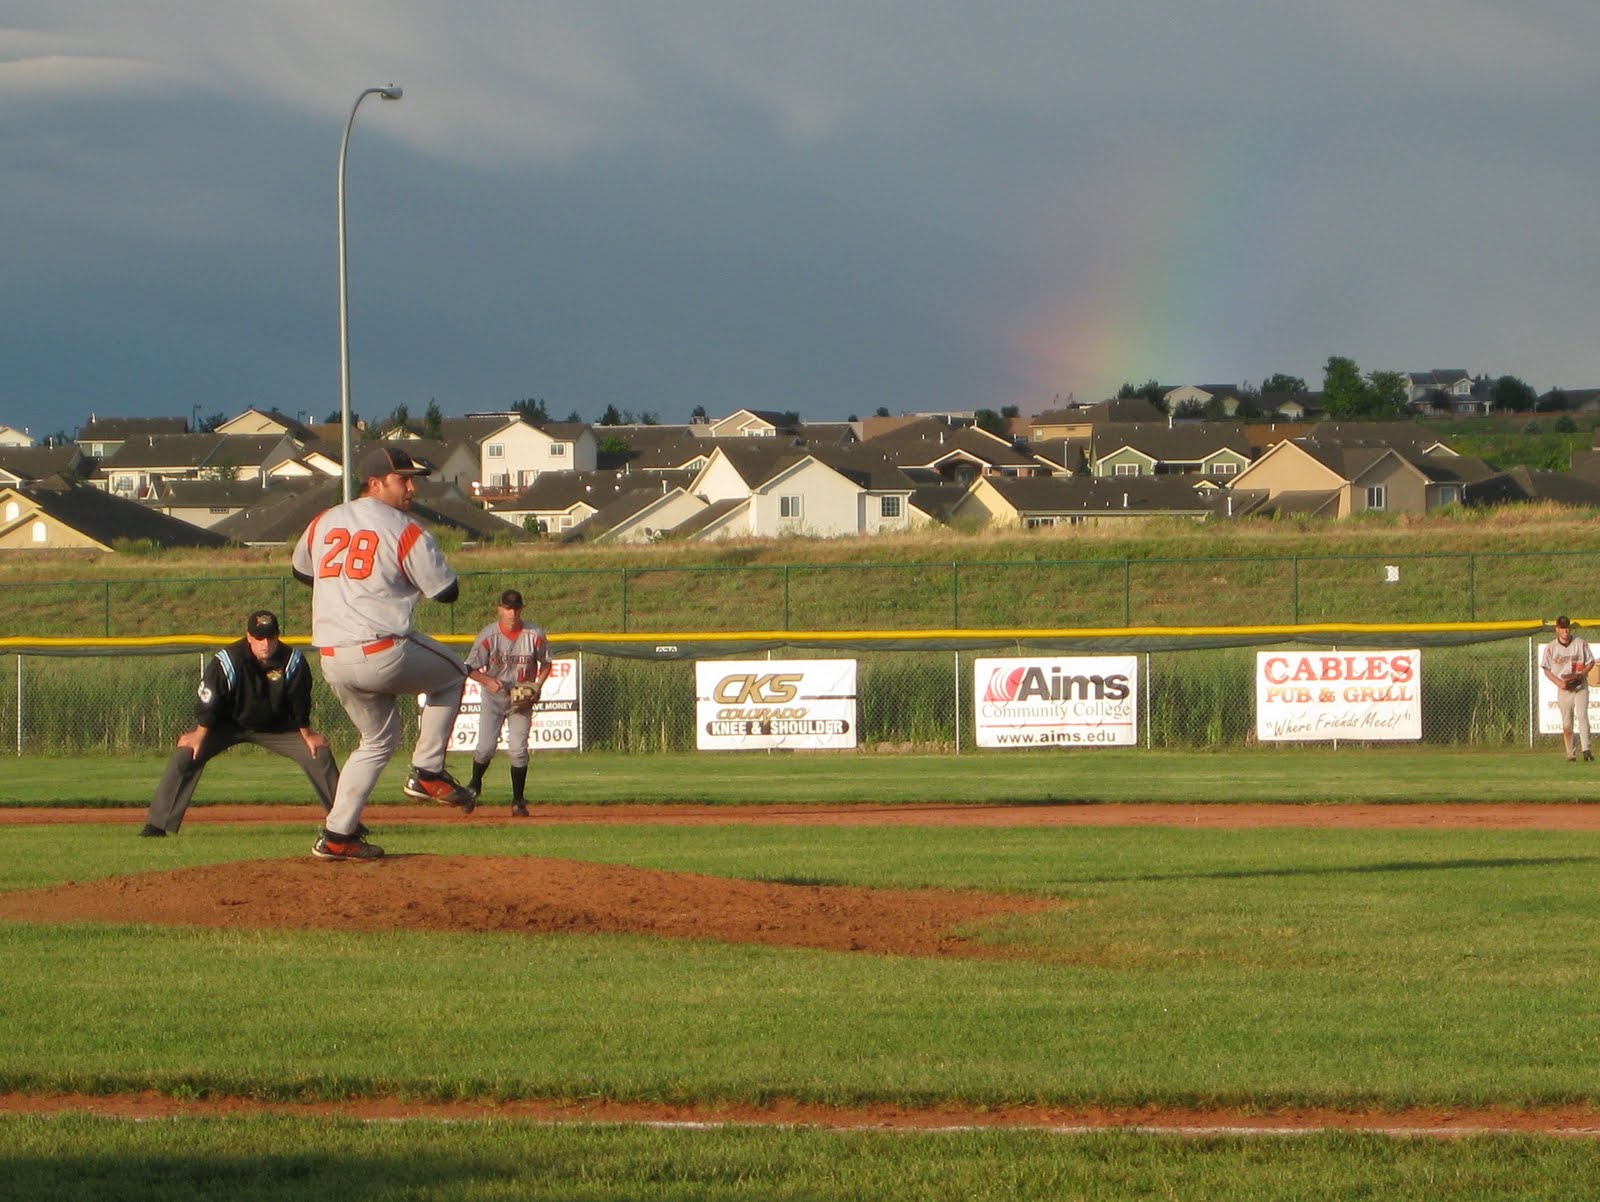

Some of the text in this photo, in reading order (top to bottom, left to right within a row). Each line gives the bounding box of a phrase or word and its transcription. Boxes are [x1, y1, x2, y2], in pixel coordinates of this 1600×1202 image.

[319, 527, 380, 581] 28
[1264, 655, 1414, 685] CABLES
[713, 673, 804, 704] CKS
[1017, 666, 1131, 702] Aims
[1266, 685, 1414, 703] PUB & GRILL
[545, 701, 574, 711] MONEY
[981, 700, 1131, 720] Community College
[456, 722, 475, 730] CALL
[545, 718, 572, 727] QUOTE
[716, 707, 809, 727] COLORADO
[1315, 712, 1360, 731] Friends
[711, 719, 843, 735] KNEE & SHOULDER
[996, 730, 1116, 744] www.aims.edu
